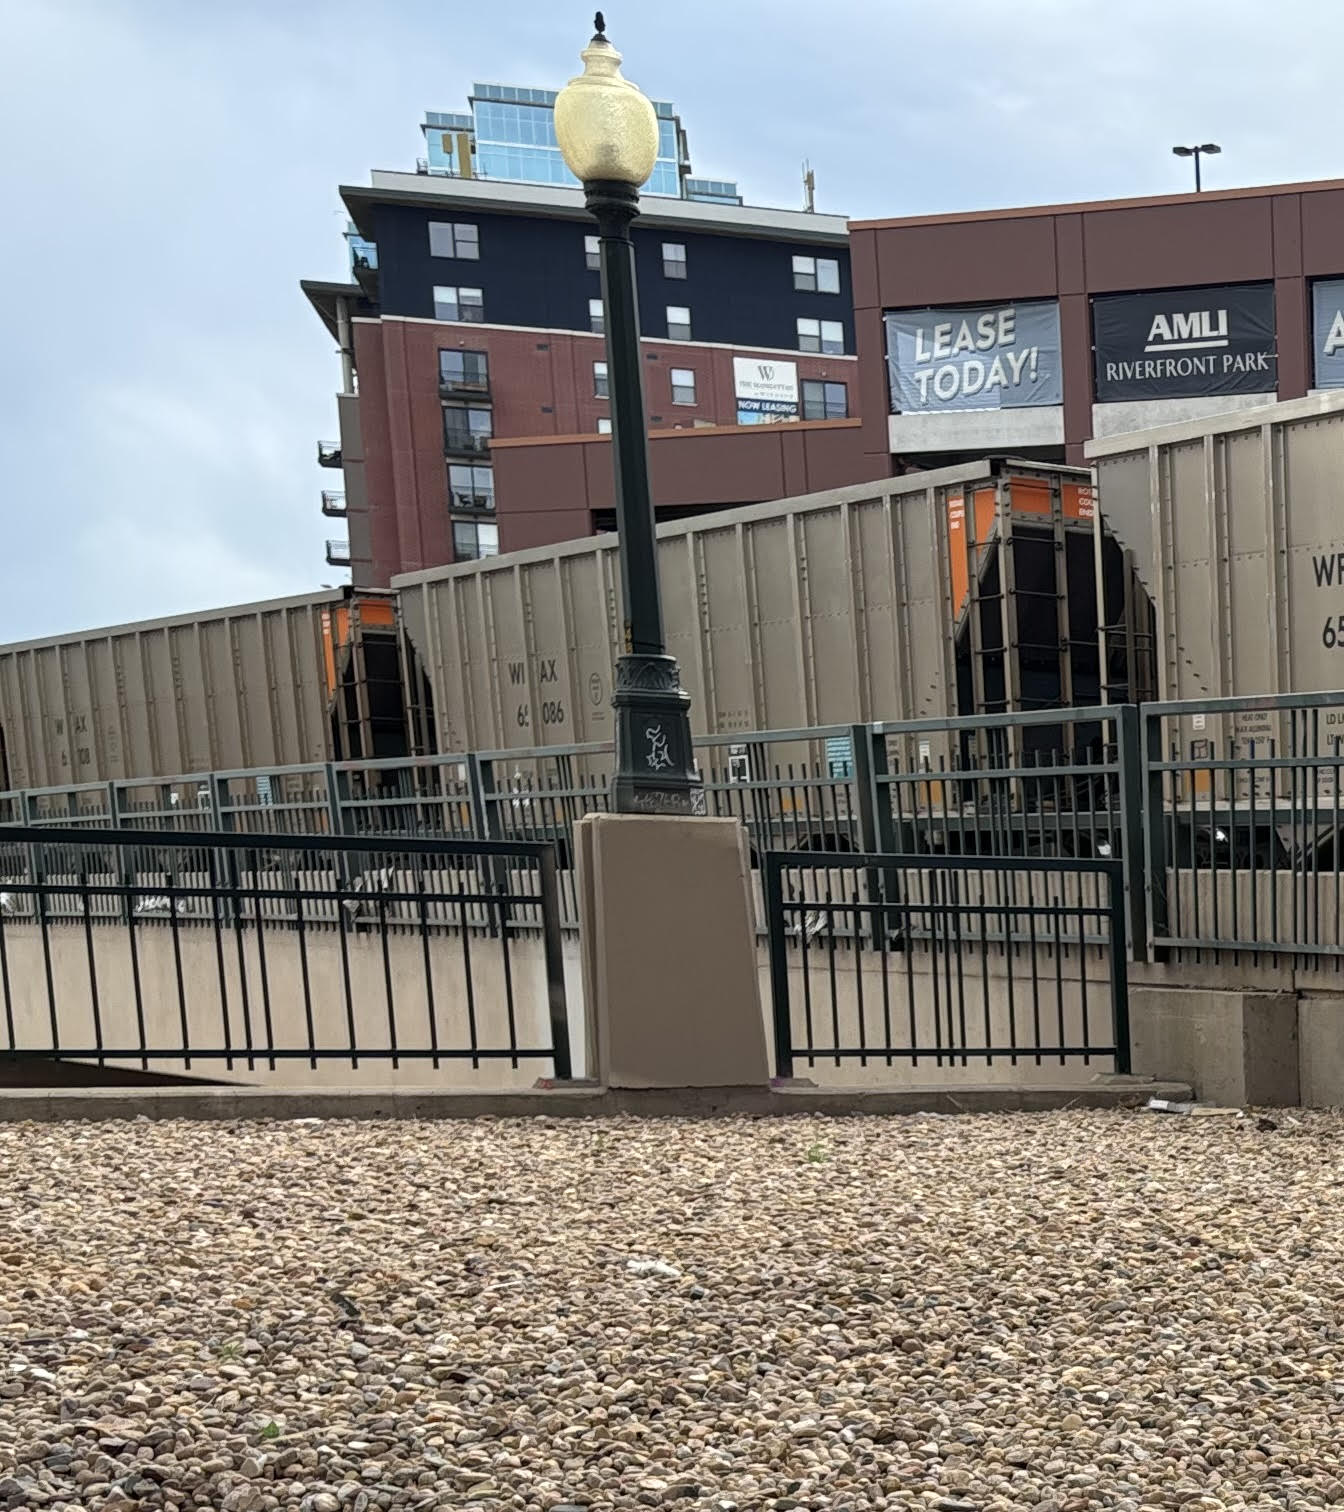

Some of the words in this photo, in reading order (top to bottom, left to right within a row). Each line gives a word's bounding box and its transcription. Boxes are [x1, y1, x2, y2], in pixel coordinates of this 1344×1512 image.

[915, 308, 1016, 364] LEASE
[1147, 310, 1228, 342] AMLI
[914, 346, 1038, 406] TODAY!
[1106, 355, 1217, 382] RIVERFRONT
[1222, 351, 1269, 374] PARK
[738, 400, 760, 410] NOW
[761, 402, 797, 413] LEASING
[540, 660, 557, 682] AX
[1326, 714, 1336, 724] LD
